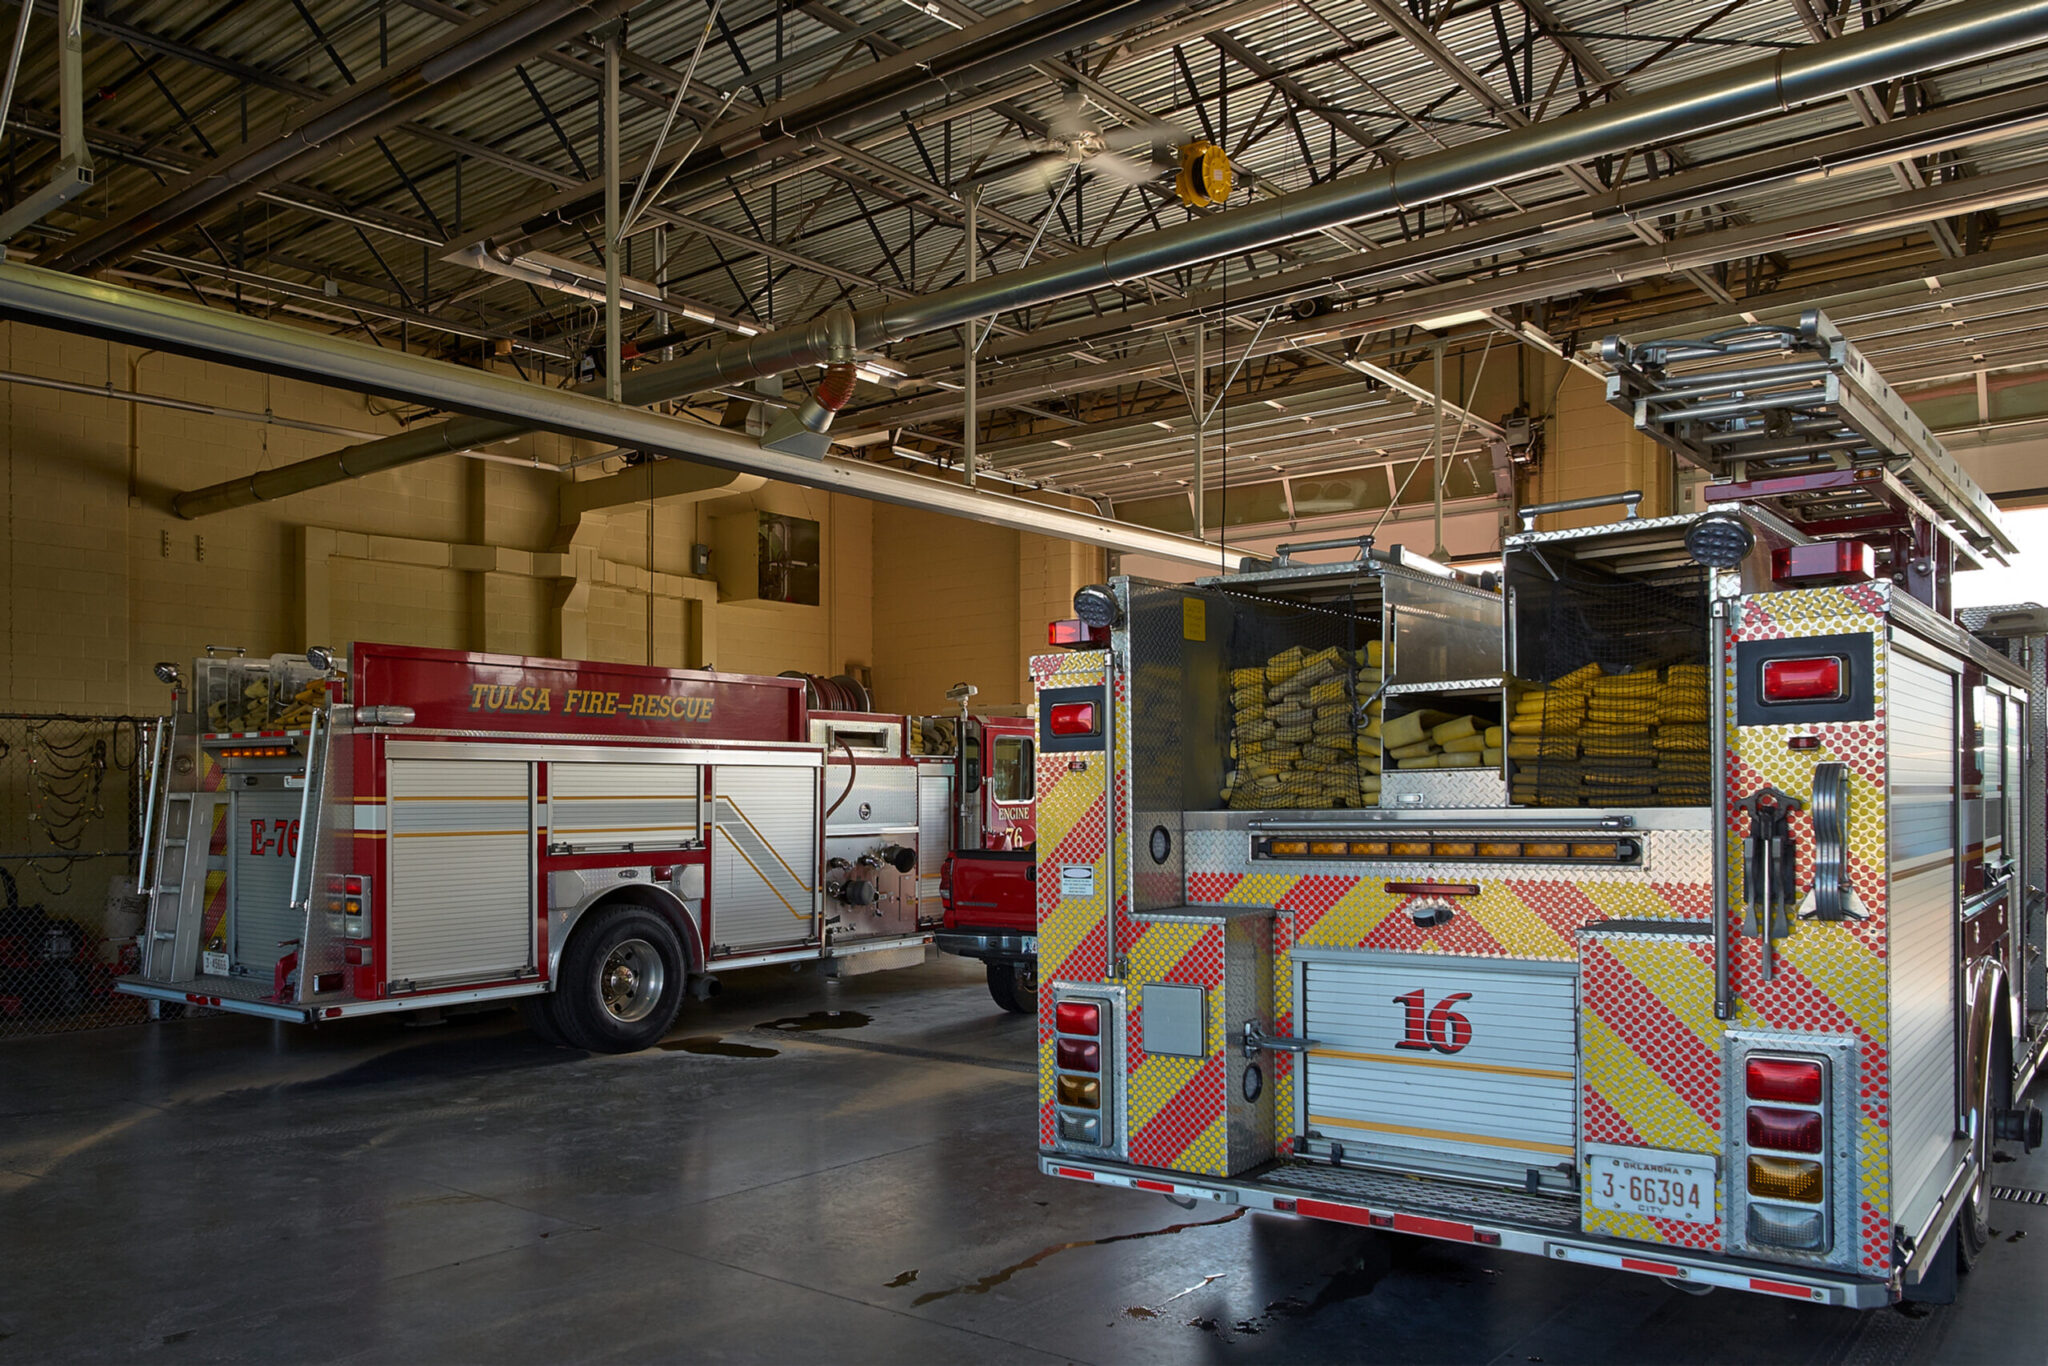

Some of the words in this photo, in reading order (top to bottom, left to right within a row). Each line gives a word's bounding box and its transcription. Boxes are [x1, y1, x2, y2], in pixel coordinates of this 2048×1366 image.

[469, 684, 551, 713] TULSA
[562, 690, 715, 721] FIRE-RESCUE
[998, 807, 1030, 821] ENGINE
[250, 818, 300, 858] E-76
[1005, 826, 1023, 849] 76
[1392, 988, 1473, 1055] 16
[1623, 1161, 1679, 1175] OKLAHOMA
[1602, 1172, 1700, 1209] 3-66394
[1638, 1204, 1665, 1214] CITY
